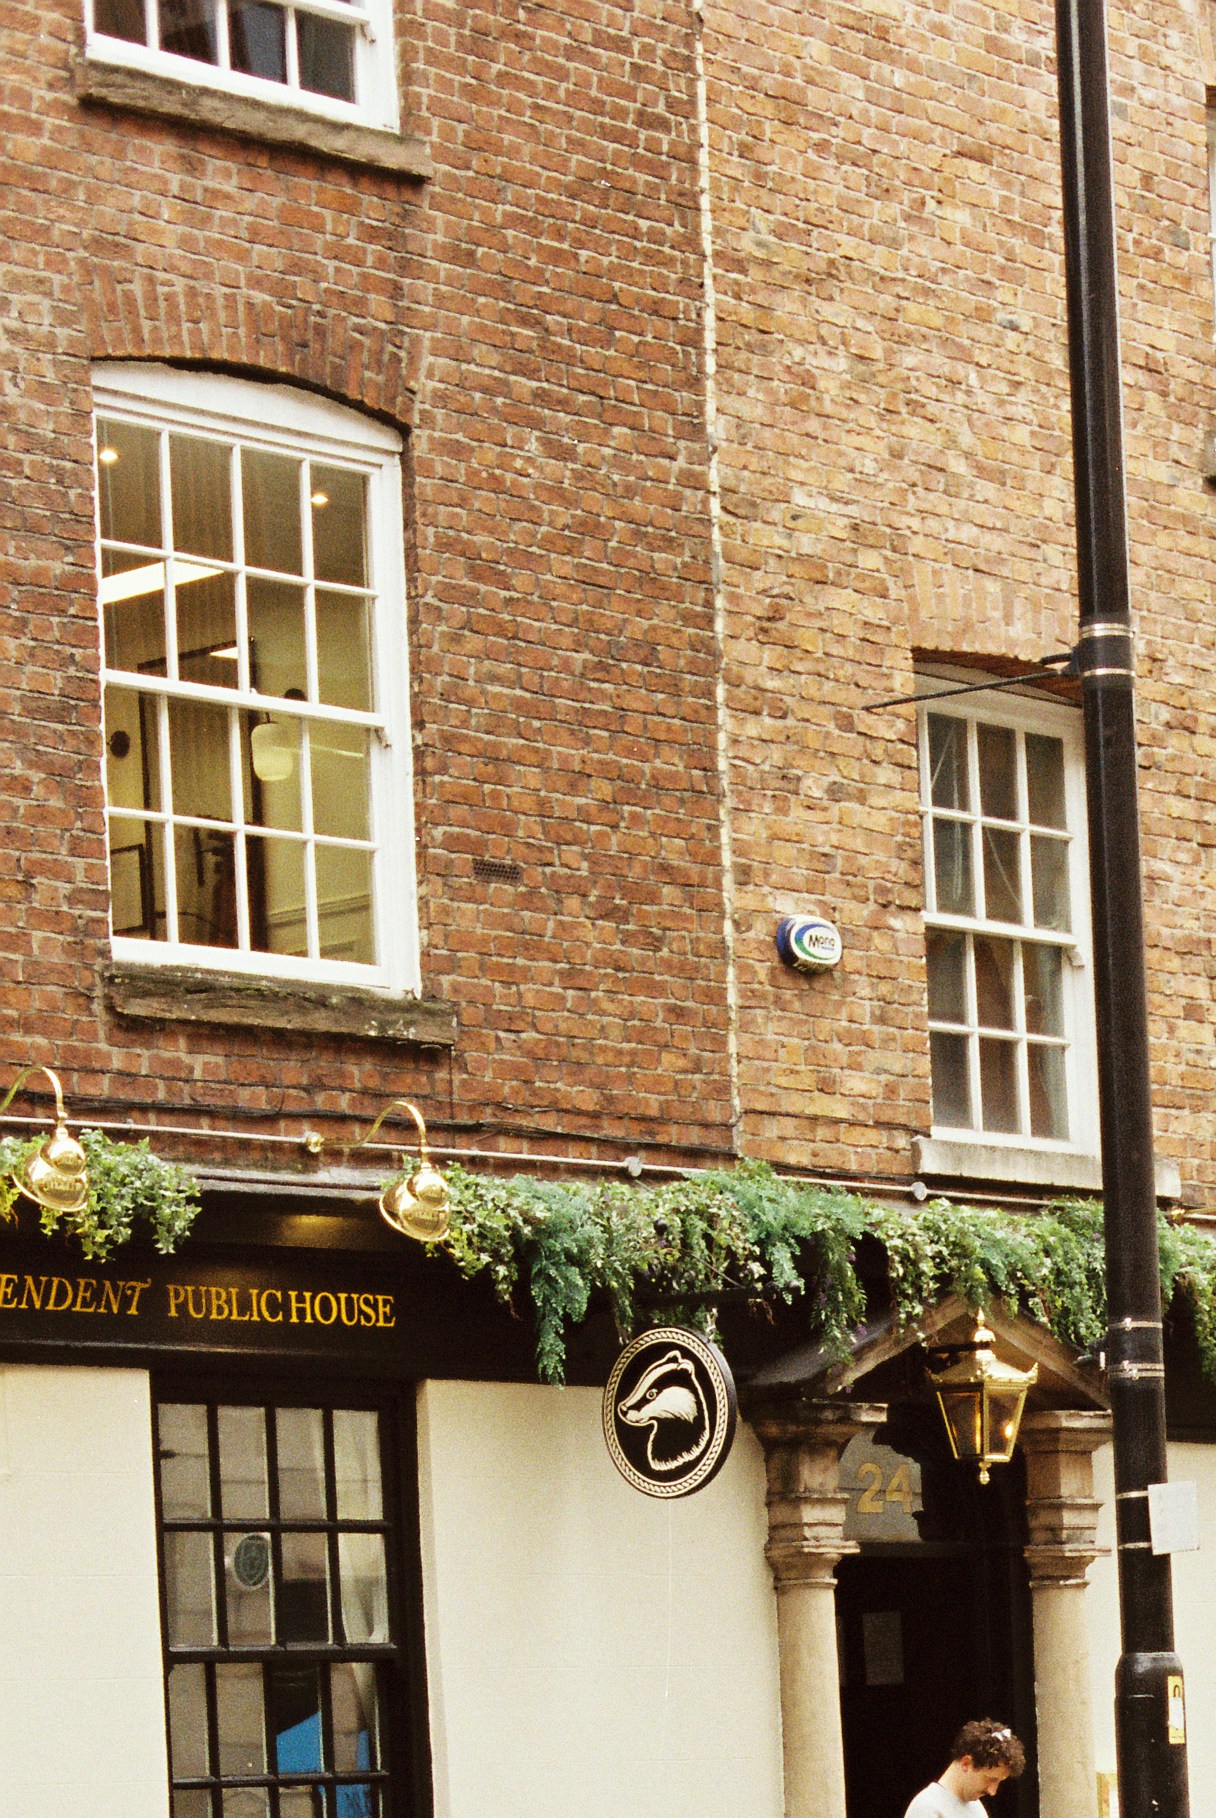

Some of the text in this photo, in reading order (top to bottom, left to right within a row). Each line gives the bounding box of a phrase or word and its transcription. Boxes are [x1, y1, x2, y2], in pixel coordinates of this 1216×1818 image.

[166, 1284, 284, 1323] PUBLIC
[289, 1291, 397, 1328] HOUSE
[857, 1462, 913, 1514] 24
